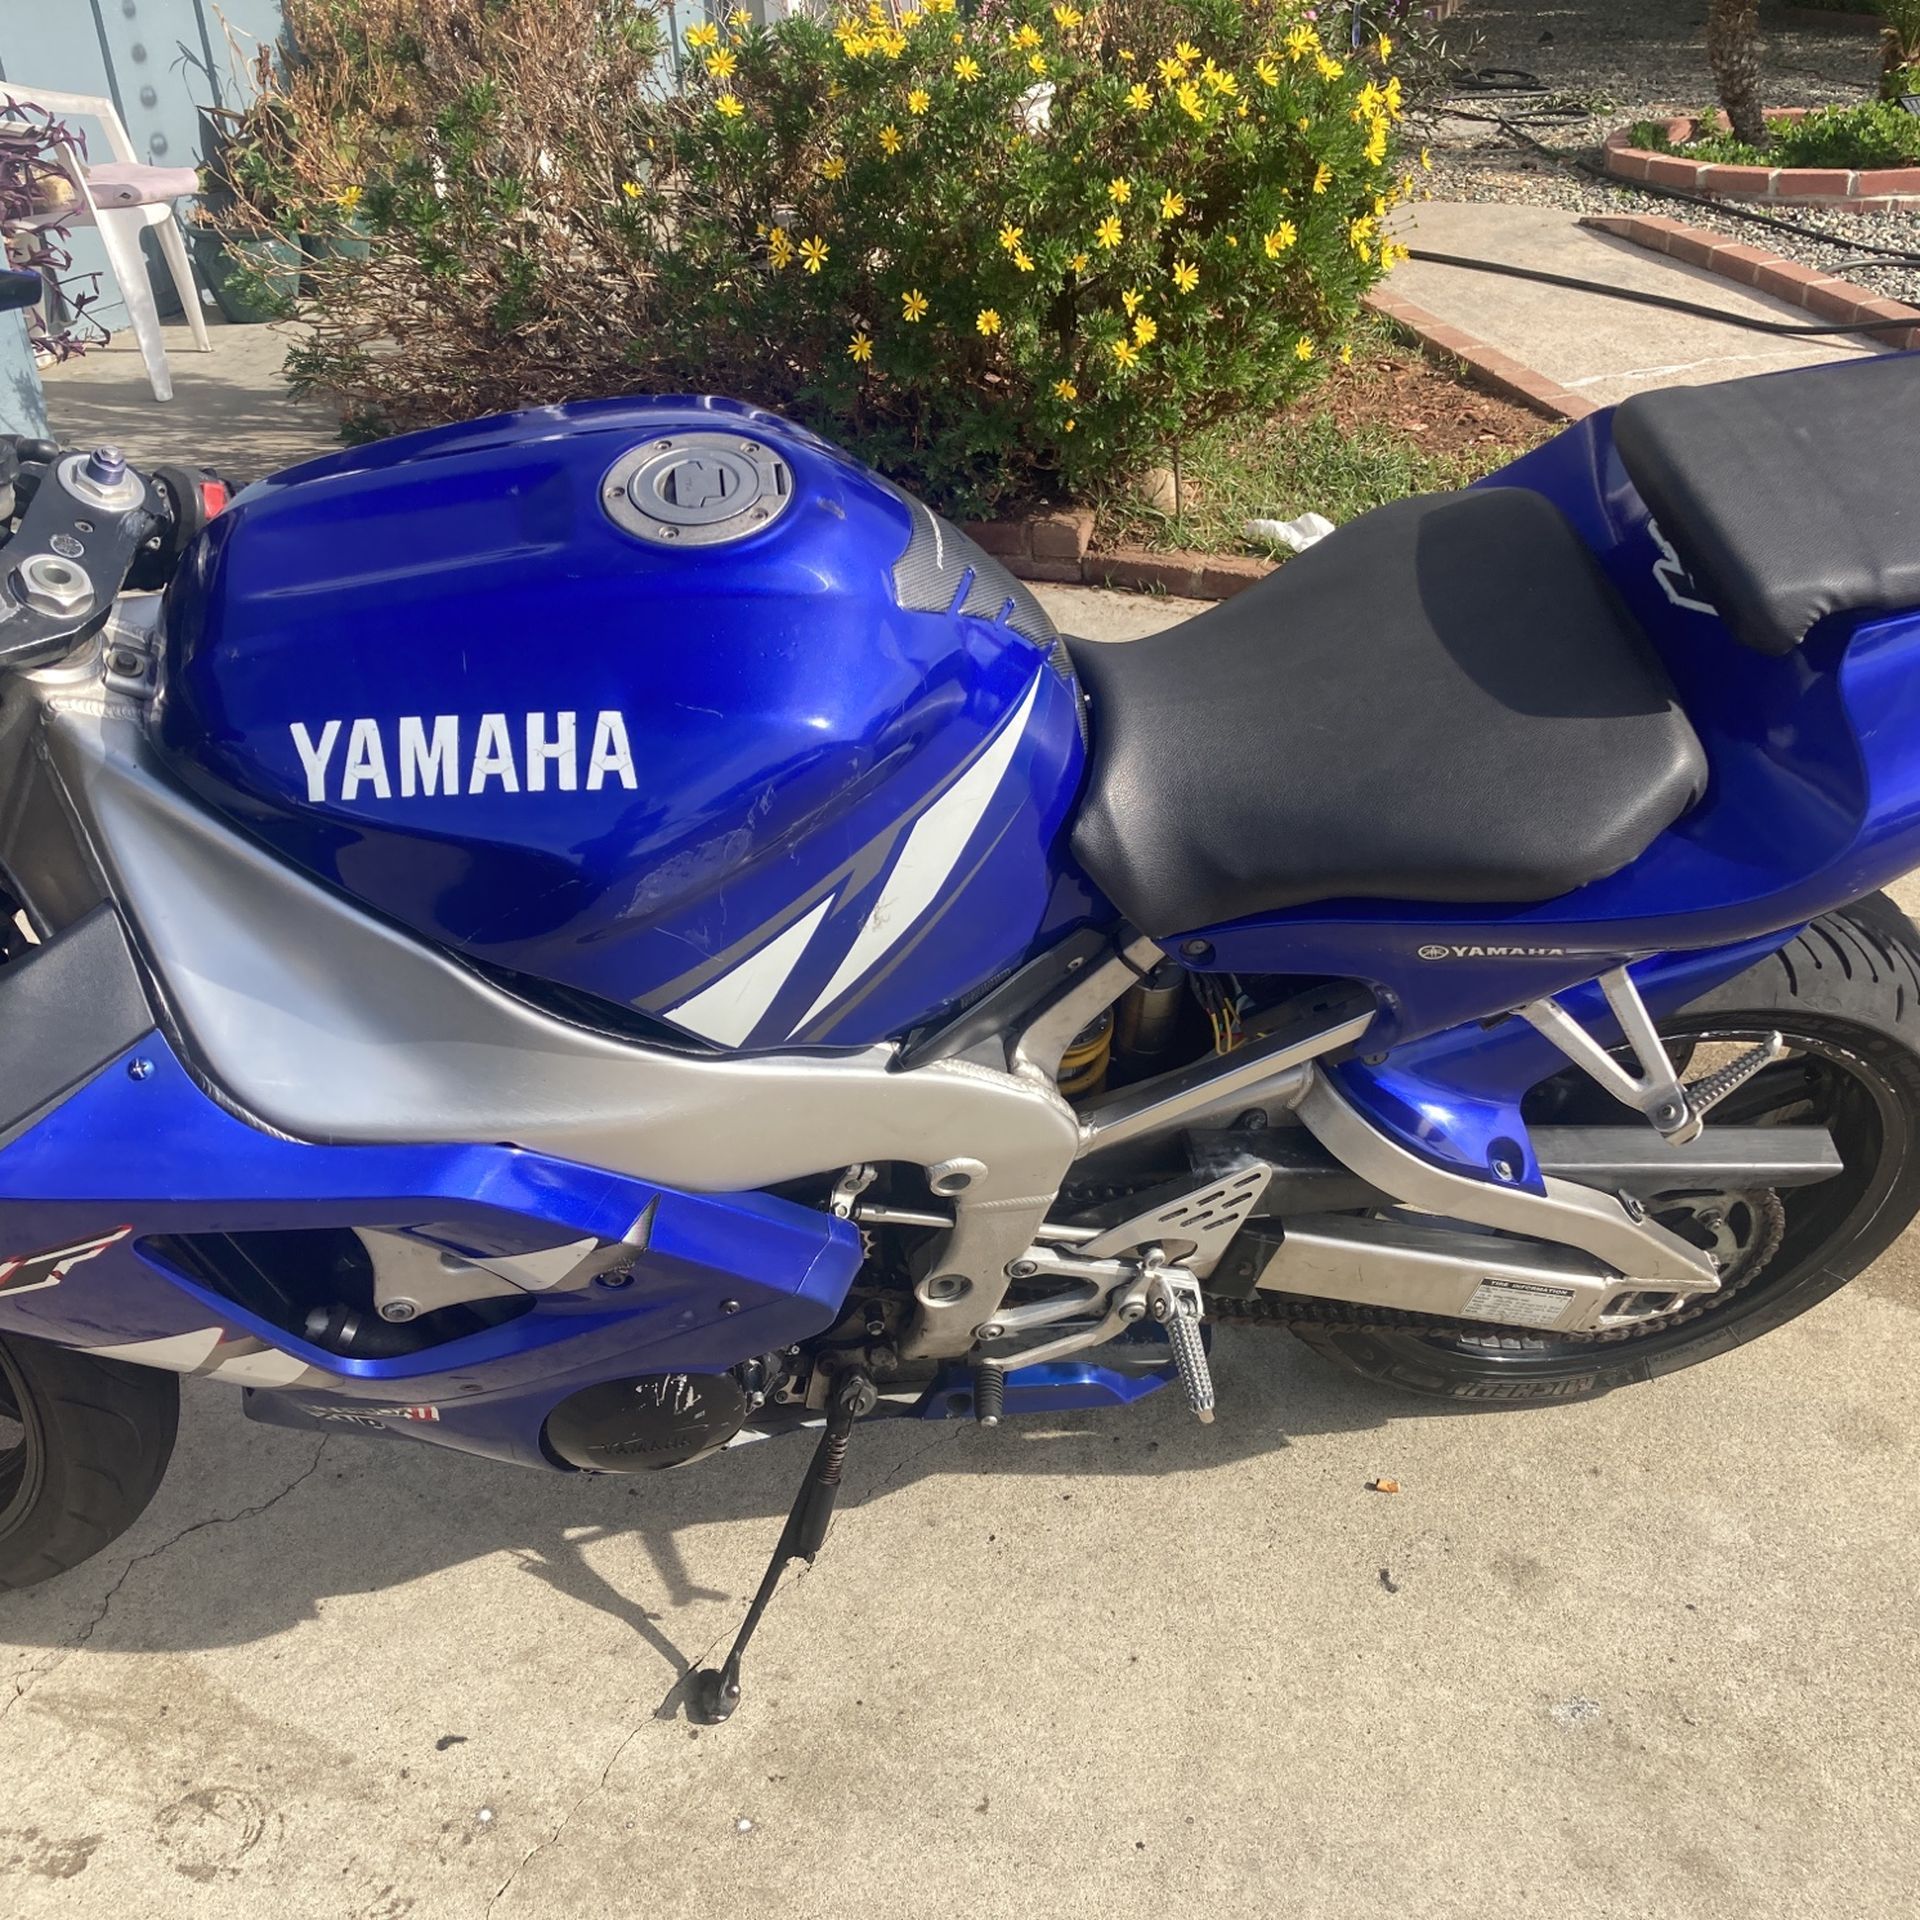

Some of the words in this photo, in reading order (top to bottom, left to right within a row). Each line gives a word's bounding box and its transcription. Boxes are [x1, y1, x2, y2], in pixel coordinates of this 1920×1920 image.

[290, 711, 638, 802] YAMAHA
[1451, 945, 1564, 957] YAMAHA
[1490, 1280, 1509, 1288] TIRE
[1512, 1283, 1569, 1295] INFORMATION
[1451, 1375, 1594, 1397] MICHELIN
[603, 1436, 692, 1454] YAMAHA
